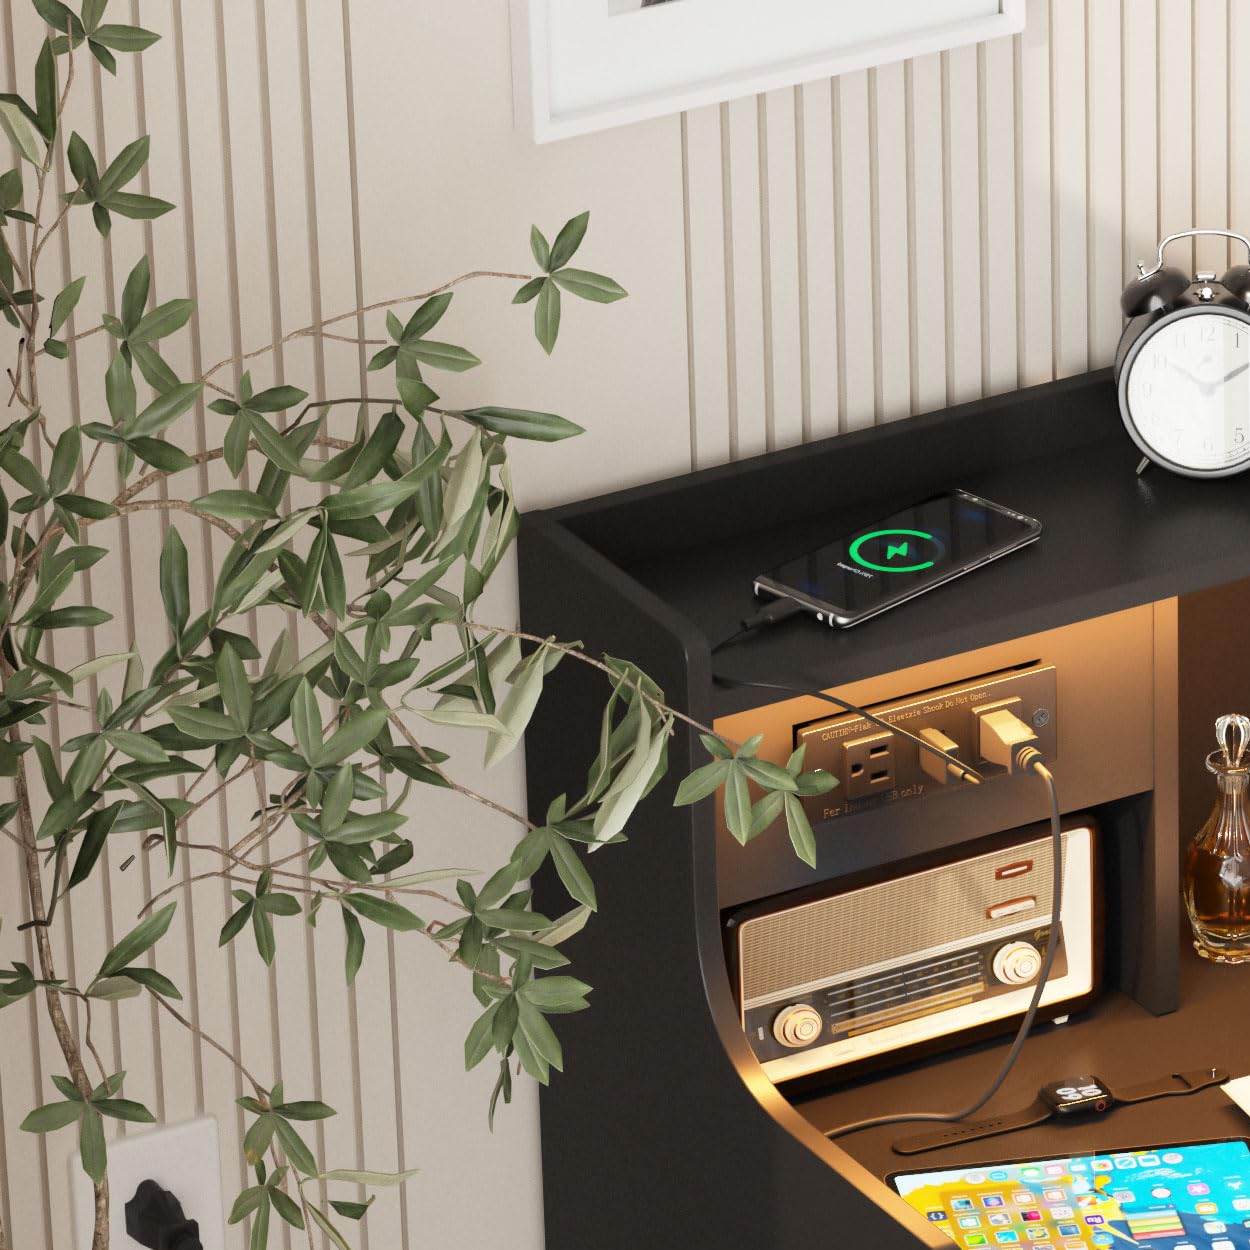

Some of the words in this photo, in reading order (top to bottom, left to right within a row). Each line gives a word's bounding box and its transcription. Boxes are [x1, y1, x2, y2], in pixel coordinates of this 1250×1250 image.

[1200, 327, 1216, 342] 12
[1234, 427, 1245, 444] 5
[1077, 1084, 1103, 1097] 10
